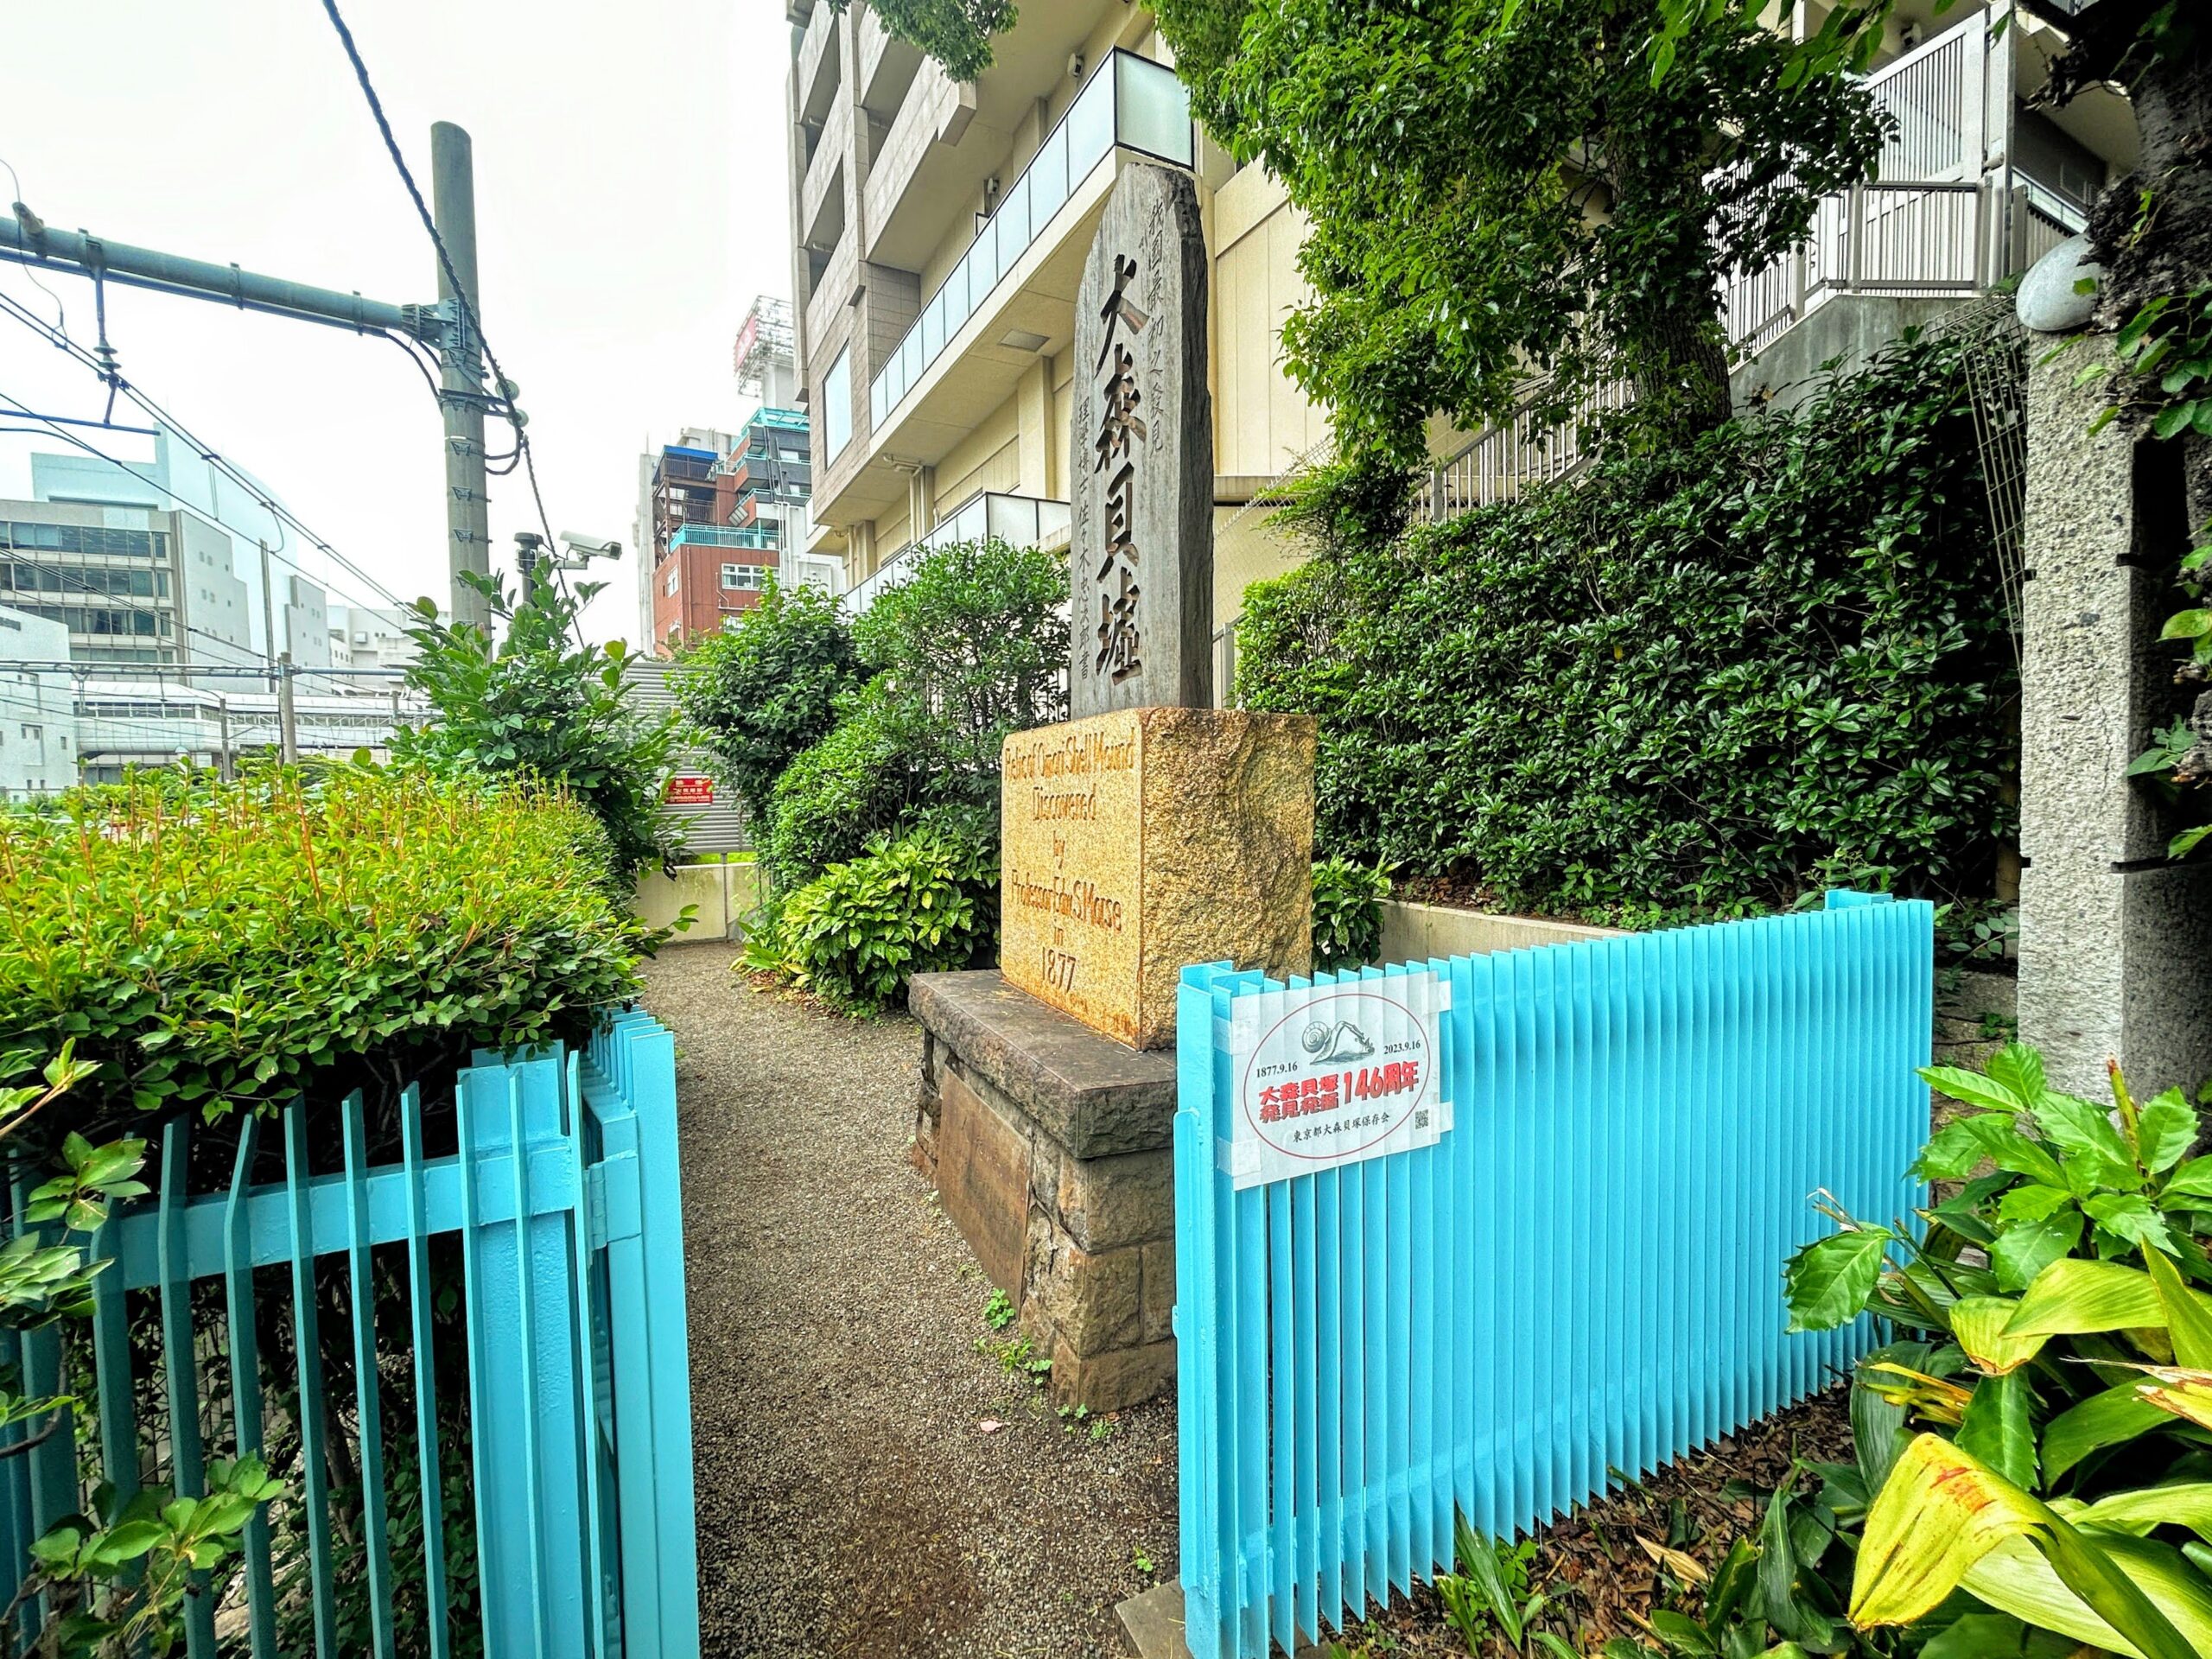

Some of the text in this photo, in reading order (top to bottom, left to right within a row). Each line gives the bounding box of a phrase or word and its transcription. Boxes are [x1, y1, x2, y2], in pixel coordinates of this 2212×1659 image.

[1065, 732, 1092, 774] Shell
[1093, 727, 1135, 772] Mound
[1033, 782, 1096, 821] Discovered
[1053, 830, 1065, 870] by
[1011, 868, 1052, 913] Professor
[1083, 881, 1122, 934] Morse
[1053, 918, 1064, 946] in
[1042, 946, 1077, 994] 1877
[1384, 1039, 1421, 1054] 2023.9.16
[1256, 1062, 1298, 1077] 1877.9.16
[1258, 1073, 1338, 1105] 大森貝塚
[1343, 1060, 1419, 1104] 146周年
[1293, 1111, 1390, 1143] 東京都大森貝塚保存会
